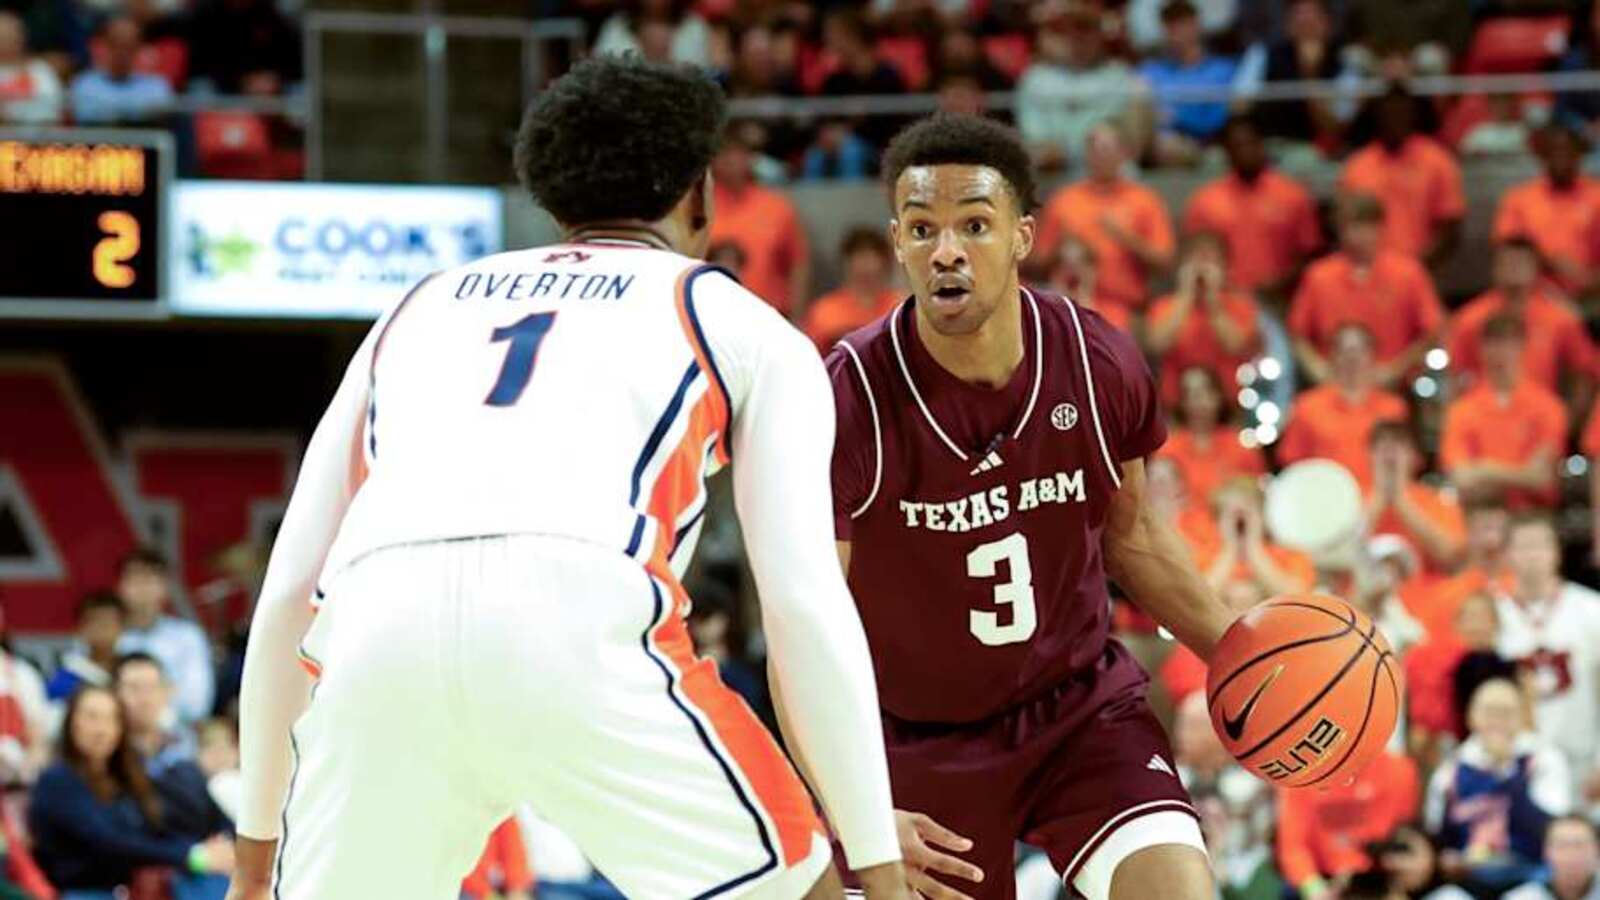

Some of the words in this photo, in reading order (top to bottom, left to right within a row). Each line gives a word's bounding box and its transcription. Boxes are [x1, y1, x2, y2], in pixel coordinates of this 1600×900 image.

[93, 210, 141, 288] 2
[455, 272, 636, 300] OVERTON
[483, 310, 558, 408] 1
[1053, 405, 1076, 427] SEC
[899, 485, 1010, 532] TEXAS
[1017, 468, 1087, 511] A&M
[966, 532, 1037, 646] 3
[1258, 717, 1342, 781] ELITE
